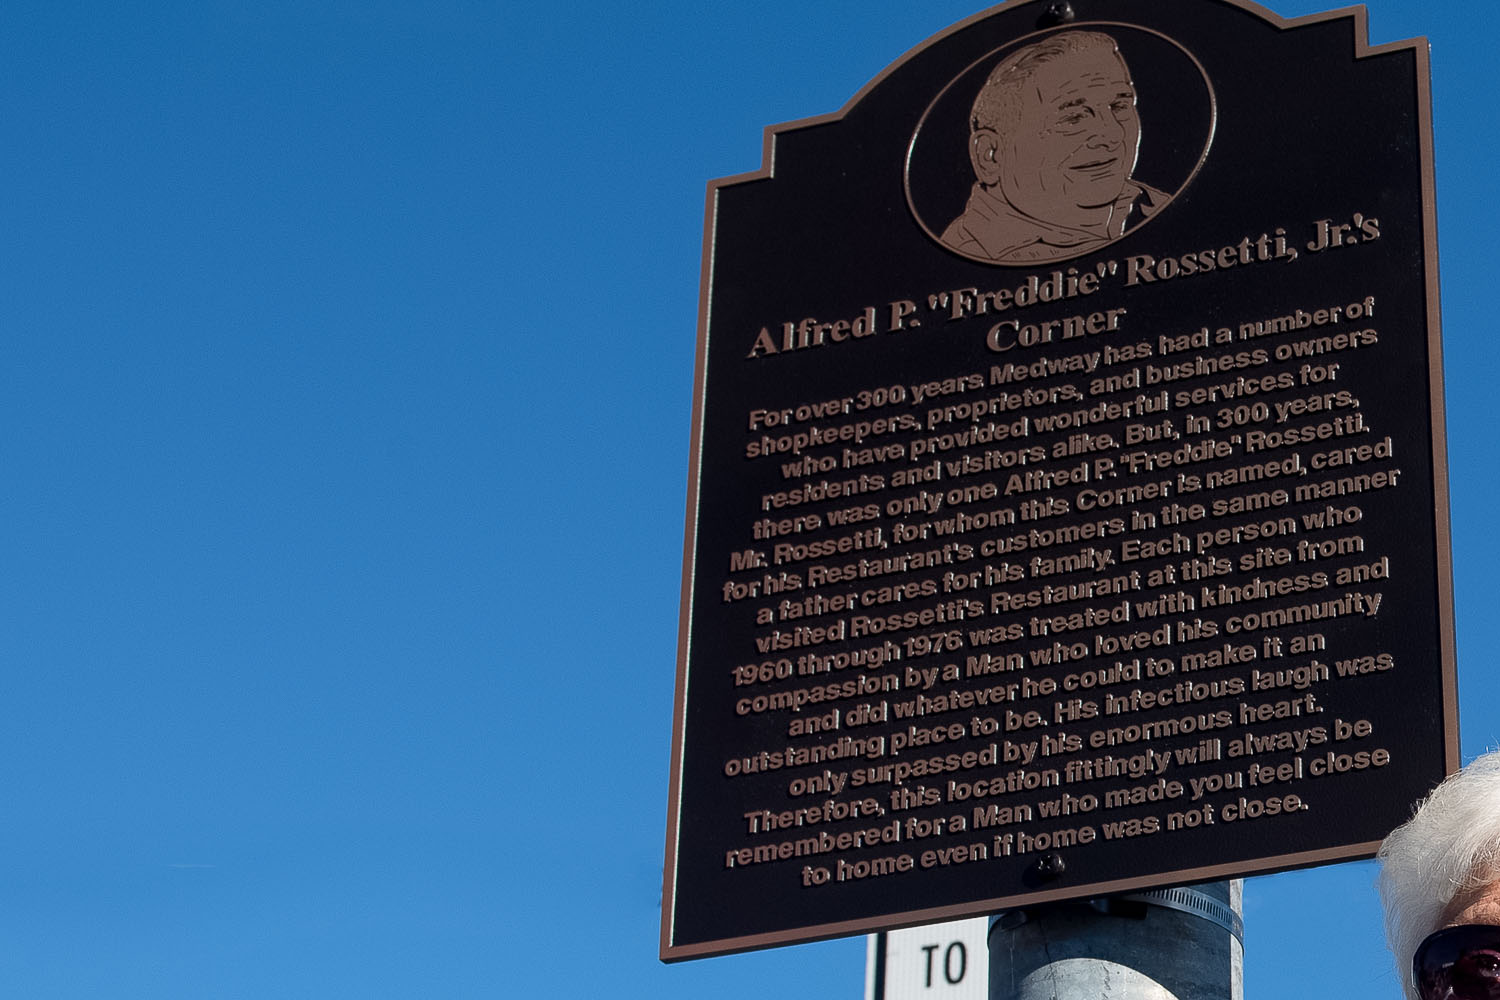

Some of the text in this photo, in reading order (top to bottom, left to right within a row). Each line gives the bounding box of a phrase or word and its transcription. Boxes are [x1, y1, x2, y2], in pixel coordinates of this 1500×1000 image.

[747, 211, 1381, 359] Alfred P. "Freddie" Rossetti, Jr.'s
[985, 306, 1128, 352] Corner
[746, 327, 1380, 459] shopkeepers, proprietors, and business owners
[748, 294, 1376, 432] For over 300 years Medway has had a number of
[781, 362, 1341, 479] who have provided wonderful services for
[729, 435, 1394, 573] Mr. Rossetti, for whom this Corner is named, cared
[752, 411, 1371, 540] there was only one Alfred P. "Freddie" Rossetti.
[761, 389, 1361, 512] residents and visitors alike. But, in 300 years,
[721, 467, 1402, 603] for his Restaurant's customers in the same manner
[755, 534, 1365, 654] visited Rossetti's Restaurant at this site from
[756, 504, 1364, 625] a father cares for his family. Each person who
[730, 555, 1391, 687] 1960 through 1976 was treated with kindness and
[735, 591, 1384, 716] compassion by a Man who loved his community
[724, 652, 1395, 777] outstanding place to be. His infectious laugh was
[788, 632, 1327, 737] and did whatever he could to make it an
[788, 692, 1325, 797] only surpassed by his enormous heart.
[725, 747, 1392, 869] remembered for a Man who made you feel close
[743, 717, 1374, 834] Therefore, this location fittingly will always be
[801, 793, 1310, 887] to home even if home was not close.
[921, 941, 968, 988] TO
